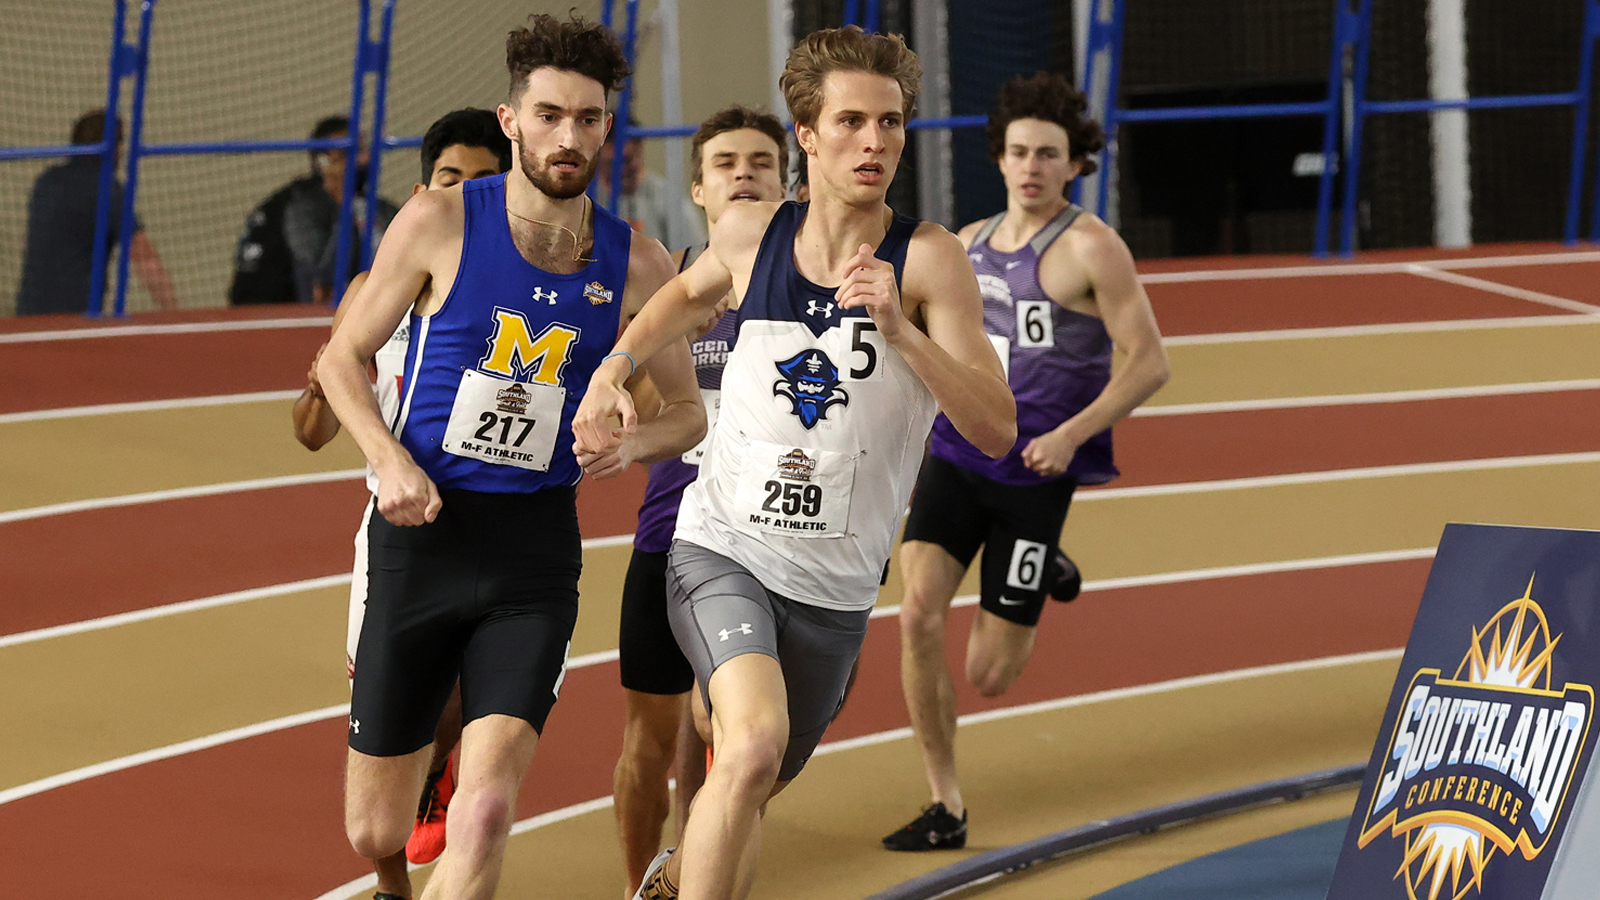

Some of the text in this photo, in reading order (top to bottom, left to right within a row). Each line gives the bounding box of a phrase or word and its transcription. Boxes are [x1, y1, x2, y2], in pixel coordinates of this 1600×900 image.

[1026, 306, 1044, 343] 6
[478, 307, 580, 387] M
[692, 340, 728, 354] CEN
[850, 322, 877, 379] 5
[474, 411, 536, 447] 217
[461, 441, 482, 452] M-F
[484, 447, 533, 462] ATHLETIC
[761, 480, 822, 517] 259
[749, 514, 771, 525] M-F
[773, 519, 827, 531] ATHLETIC
[1018, 547, 1039, 585] 6
[1373, 685, 1586, 834] SOUTHLAND
[1404, 775, 1523, 825] CONFERENCE
